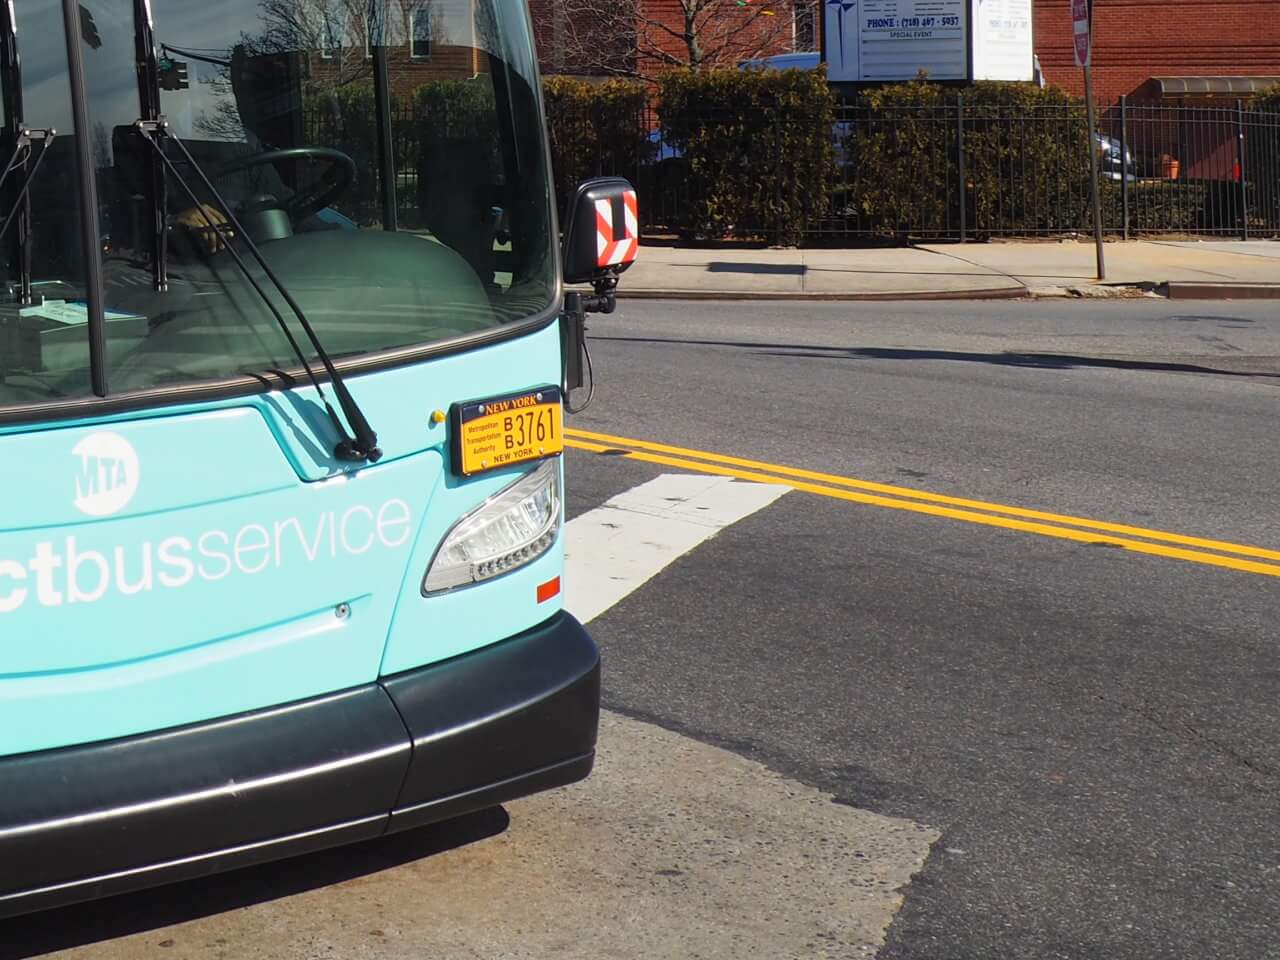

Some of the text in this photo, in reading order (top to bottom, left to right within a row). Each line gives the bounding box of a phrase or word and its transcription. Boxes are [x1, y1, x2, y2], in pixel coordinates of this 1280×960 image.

[867, 18, 895, 28] PHONE
[901, 17, 920, 28] (718)
[485, 394, 537, 416] NEW YORK
[493, 447, 534, 464] NEW YORK
[70, 451, 129, 499] MTA
